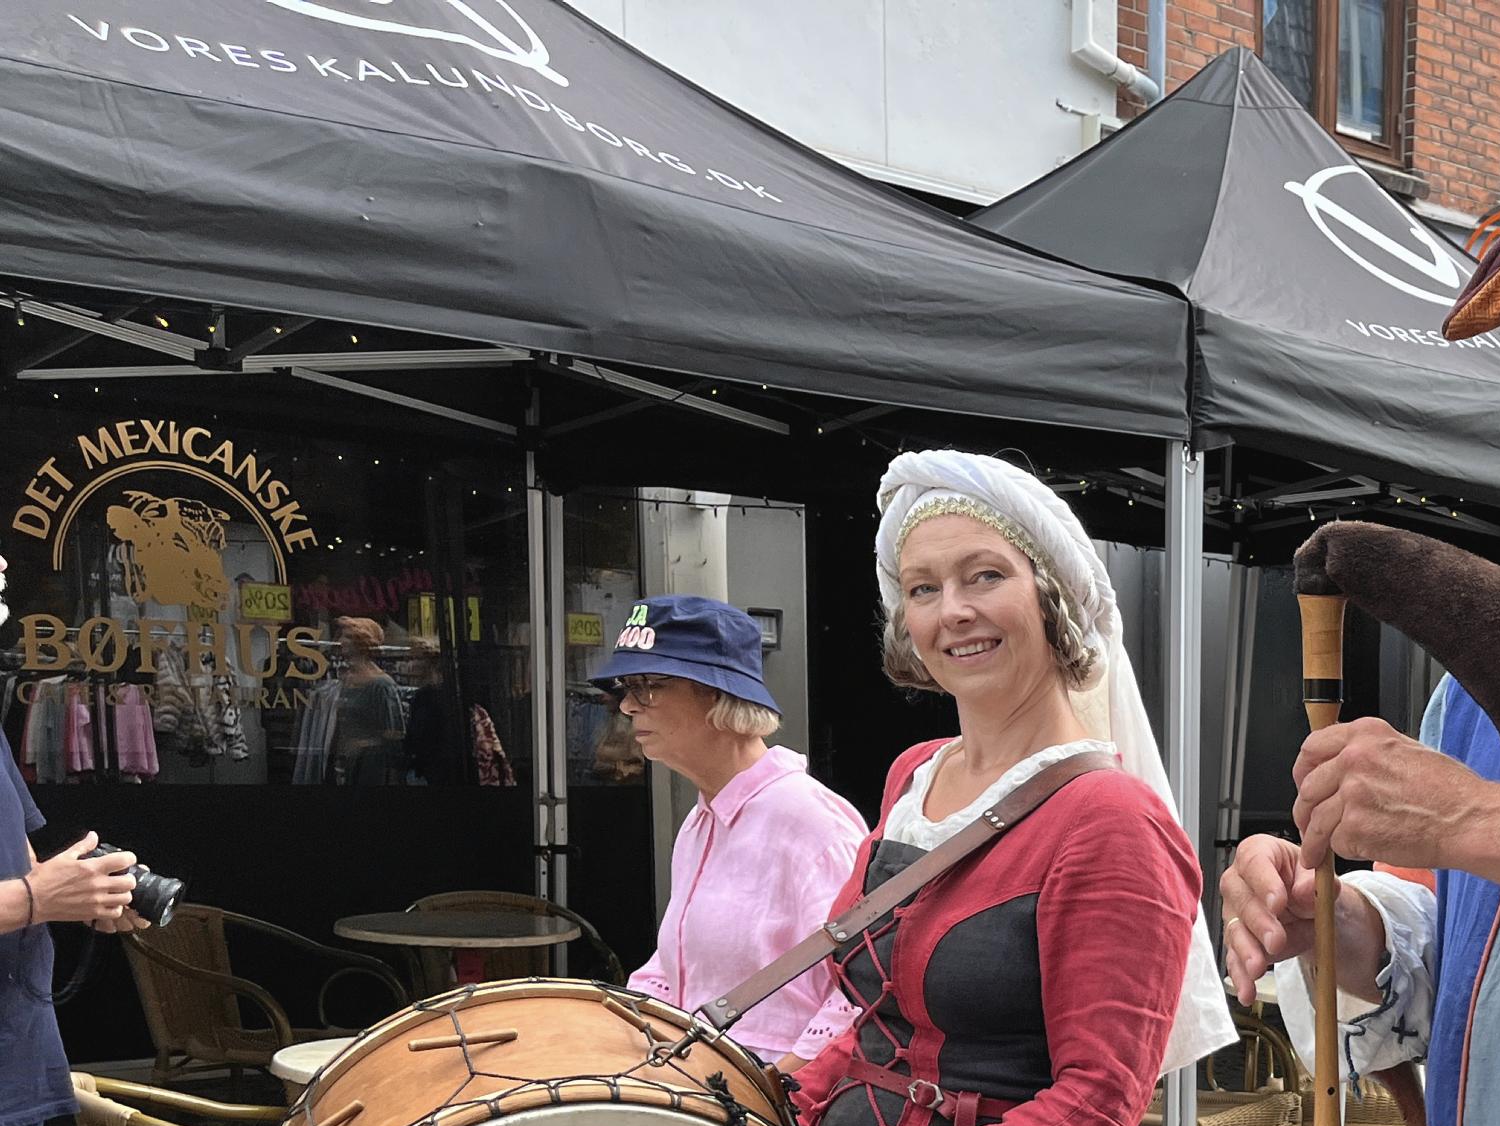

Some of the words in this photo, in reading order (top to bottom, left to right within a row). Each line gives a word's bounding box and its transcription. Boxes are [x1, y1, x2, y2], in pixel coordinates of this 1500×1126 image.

[68, 14, 298, 73] VORES
[306, 54, 783, 203] KALUNDBORG.DK
[1345, 319, 1450, 348] VORES
[12, 456, 74, 539] DET
[77, 419, 319, 553] MEXICANSKE
[18, 613, 330, 680] BØFHUS
